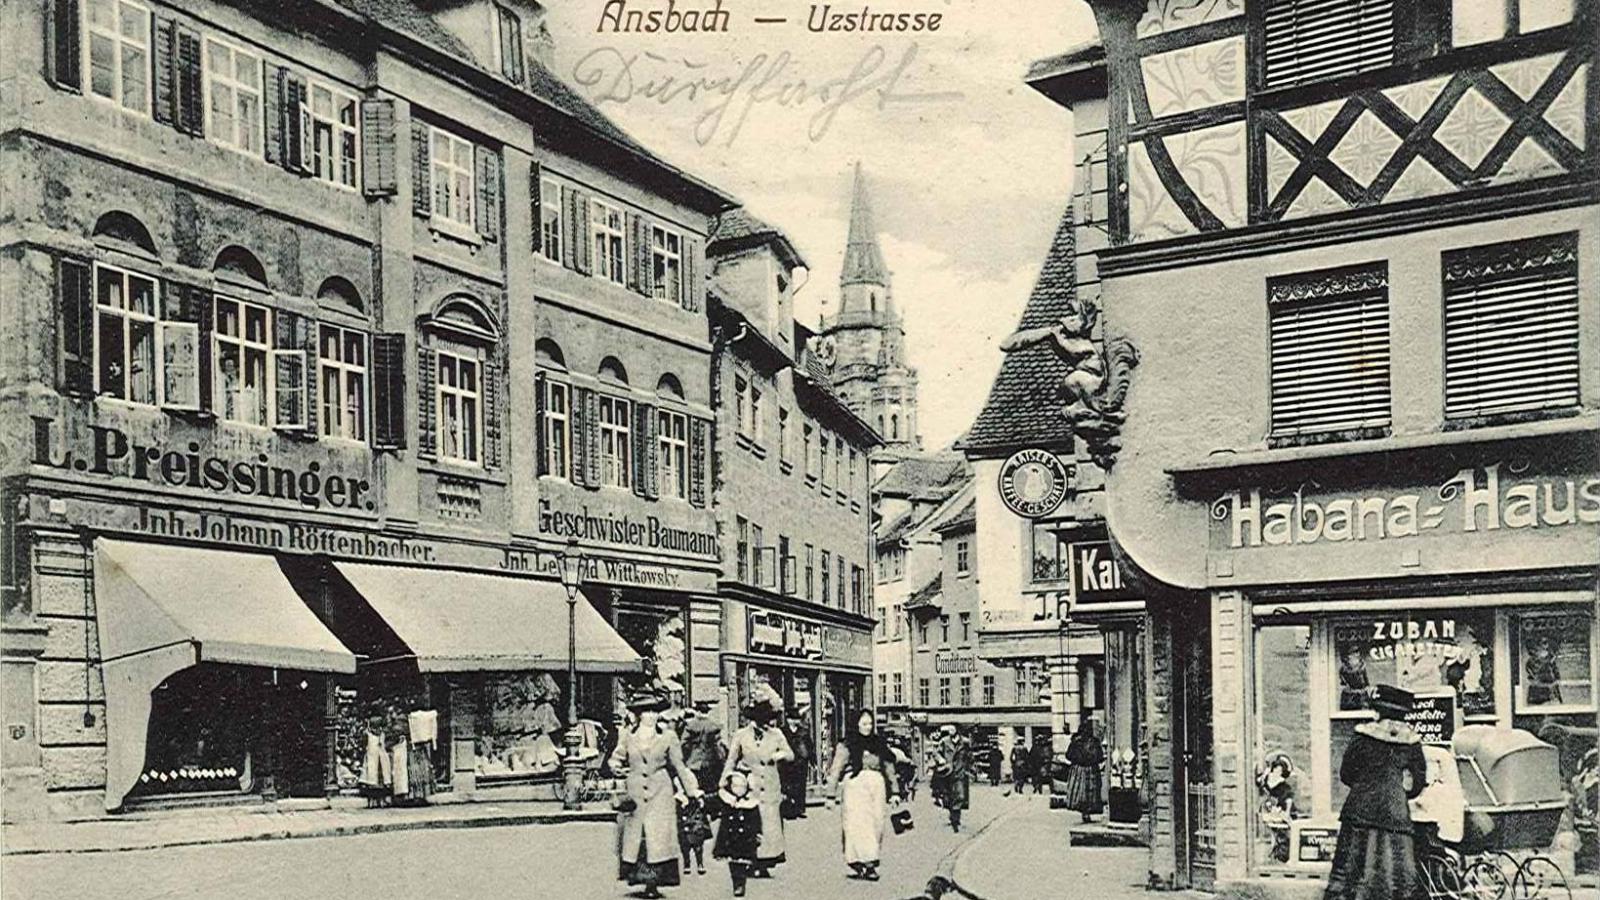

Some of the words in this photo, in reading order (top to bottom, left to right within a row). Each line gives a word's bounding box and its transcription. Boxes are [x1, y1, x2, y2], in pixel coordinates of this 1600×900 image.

[538, 499, 646, 547] Geschwister
[647, 515, 717, 556] Baumann
[1373, 619, 1456, 640] ZUBAN
